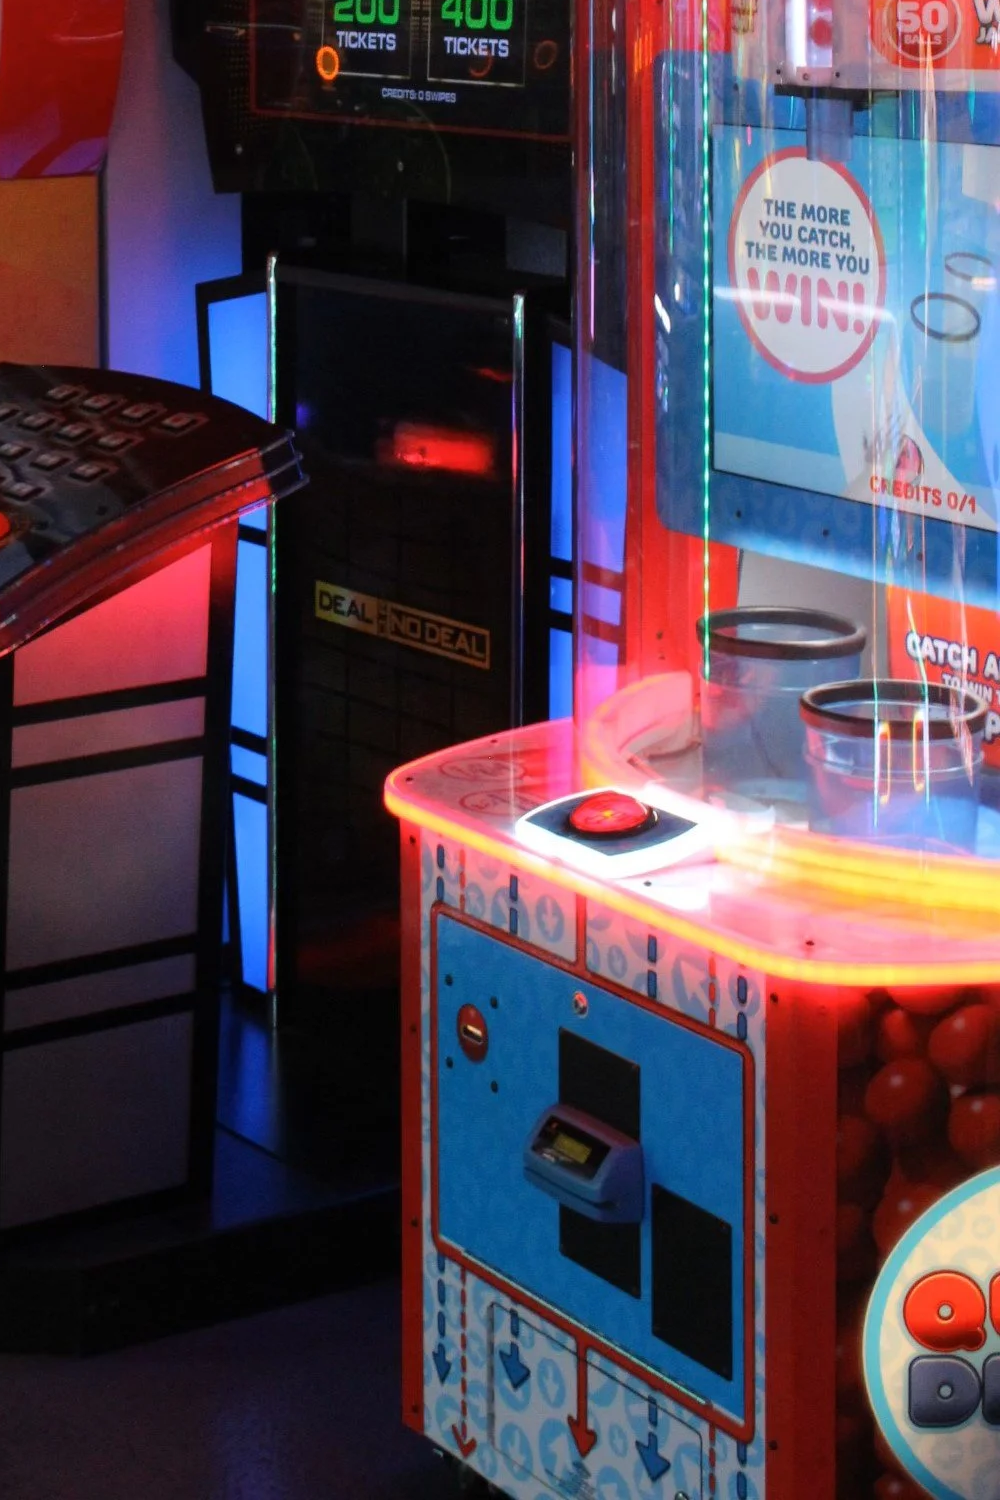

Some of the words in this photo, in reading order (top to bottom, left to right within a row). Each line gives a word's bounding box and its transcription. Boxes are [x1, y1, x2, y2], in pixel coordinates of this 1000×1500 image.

[896, 0, 949, 34] 50
[336, 31, 396, 50] TICKETS
[444, 36, 509, 57] TICKETS
[425, 91, 456, 103] SWIPES
[763, 198, 796, 219] THE
[801, 203, 851, 227] MORE
[760, 220, 792, 242] YOU
[797, 228, 856, 252] CATCH,
[745, 241, 778, 261] THE
[782, 247, 831, 270] MORE
[836, 253, 870, 275] YOU
[747, 266, 866, 336] WIN!
[870, 475, 942, 507] CREDITS
[947, 492, 976, 514] 0/1
[319, 590, 372, 624] DEAL
[391, 612, 421, 640] NO
[425, 622, 485, 658] DEAL
[906, 631, 978, 674] CATCH
